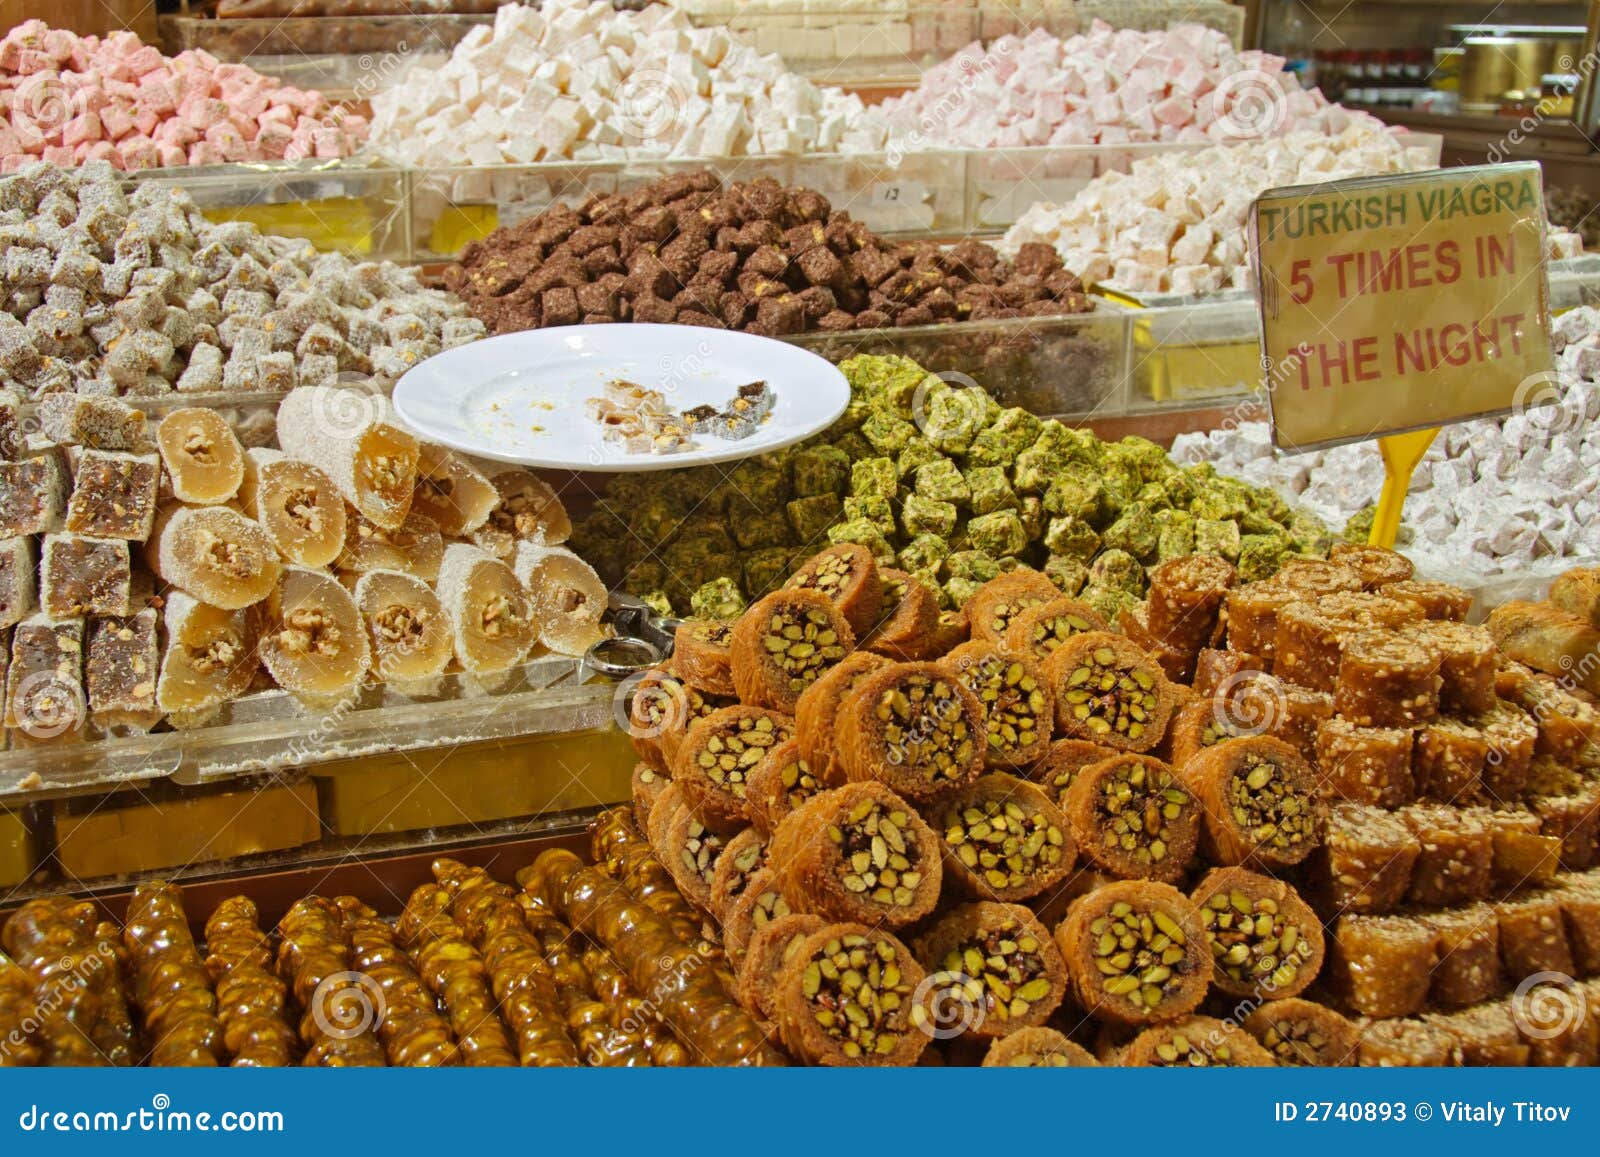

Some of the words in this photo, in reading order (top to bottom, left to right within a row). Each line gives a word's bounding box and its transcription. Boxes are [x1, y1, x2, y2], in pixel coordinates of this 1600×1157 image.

[1259, 194, 1407, 241] TURKISH
[1417, 179, 1537, 223] VIAGRA
[1290, 259, 1314, 305] 5
[1327, 239, 1463, 299] TIMES
[1475, 232, 1517, 279] IN
[1287, 336, 1382, 391] THE
[1393, 313, 1526, 376] NIGHT
